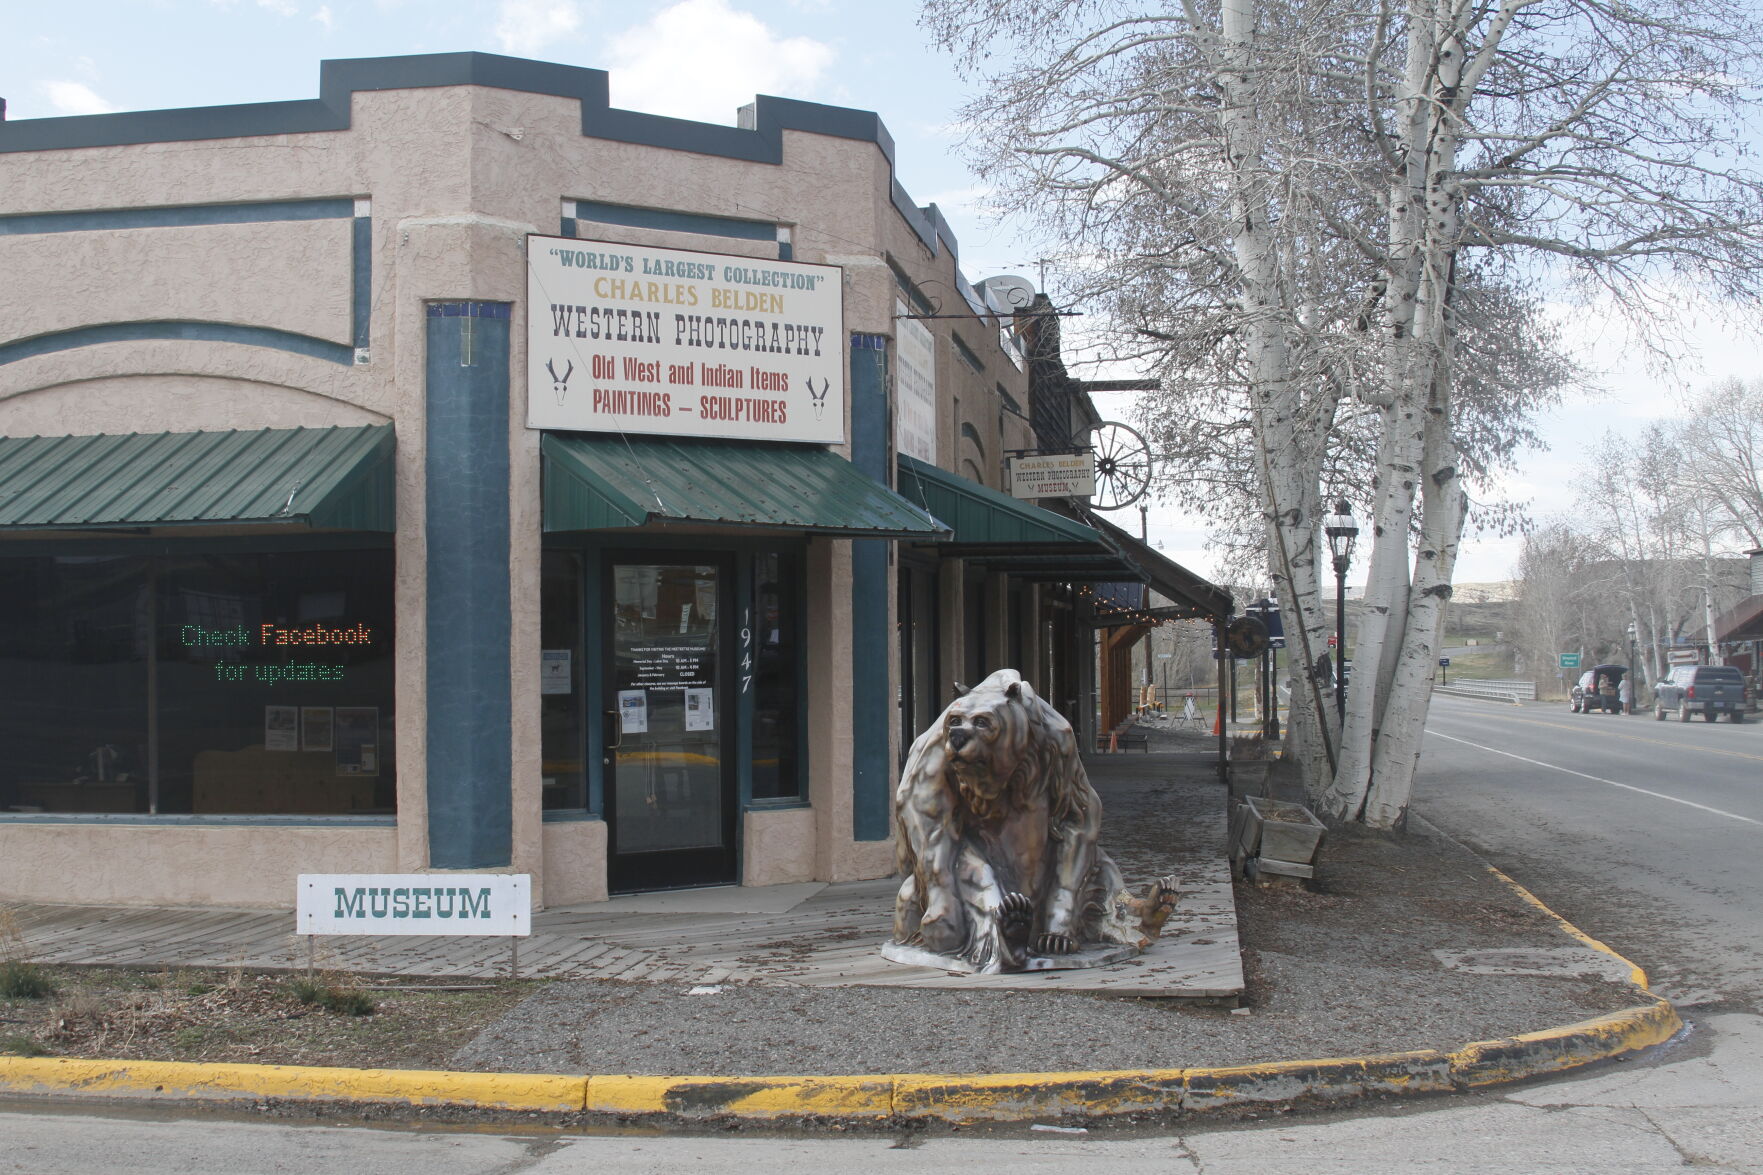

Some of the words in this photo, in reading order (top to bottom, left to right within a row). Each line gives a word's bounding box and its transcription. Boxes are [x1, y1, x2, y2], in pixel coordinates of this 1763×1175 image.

[643, 259, 715, 281] LARGEST
[594, 277, 698, 306] CHARLES
[711, 287, 785, 314] BELDEN
[551, 303, 661, 344] WESTERN
[675, 313, 824, 357] PHOTOGRAPHY
[592, 354, 615, 381] Old
[623, 357, 661, 384] West
[668, 361, 694, 386] and
[701, 362, 743, 389] Indian
[751, 366, 789, 392] Items
[593, 388, 671, 417] PAINTINGS
[700, 395, 787, 424] SCULPTURES
[1016, 471, 1045, 482] WESTERN
[1048, 469, 1090, 480] PHOTOGRAPHY
[1019, 461, 1055, 470] CHARLES
[1058, 460, 1085, 468] BELDEN
[1037, 482, 1069, 493] MUSEUM
[182, 624, 250, 646] Check
[261, 623, 371, 645] Facebook
[741, 608, 752, 694] 1947
[215, 660, 248, 681] for
[256, 659, 344, 686] updates
[334, 888, 491, 919] MUSEUM
